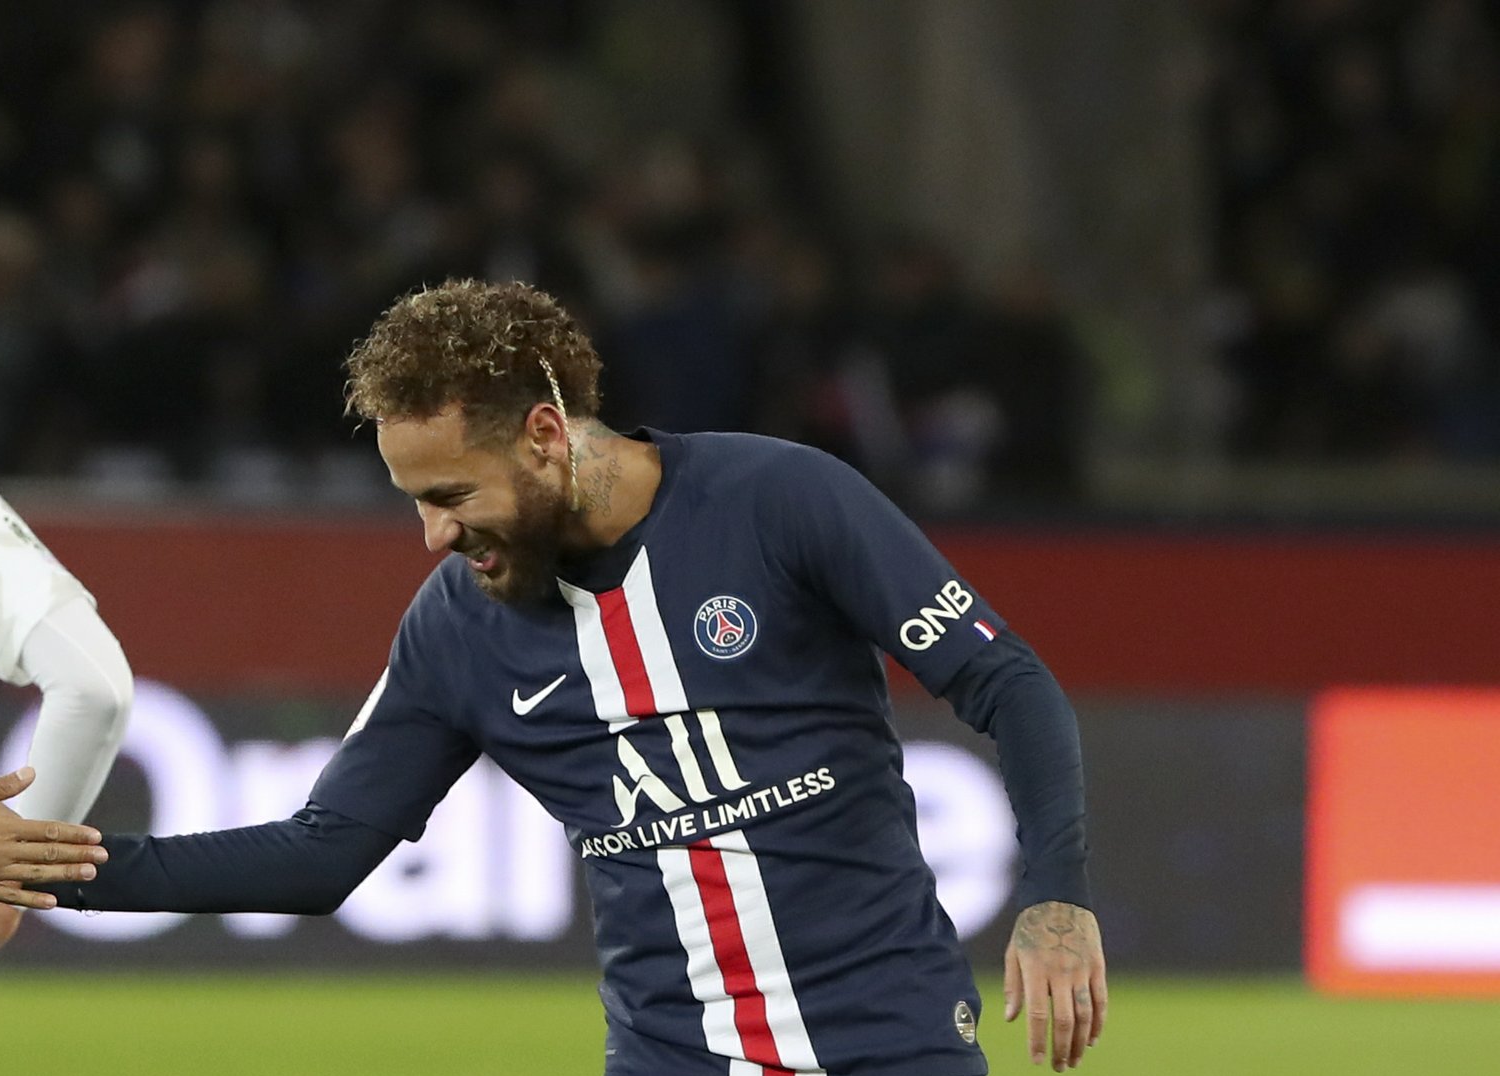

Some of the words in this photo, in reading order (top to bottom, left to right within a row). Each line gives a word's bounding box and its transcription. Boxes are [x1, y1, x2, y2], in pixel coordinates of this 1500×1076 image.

[699, 599, 737, 622] PARIS
[900, 580, 973, 651] QNB
[636, 813, 697, 847] LIVE
[702, 767, 836, 830] LIMITLESS
